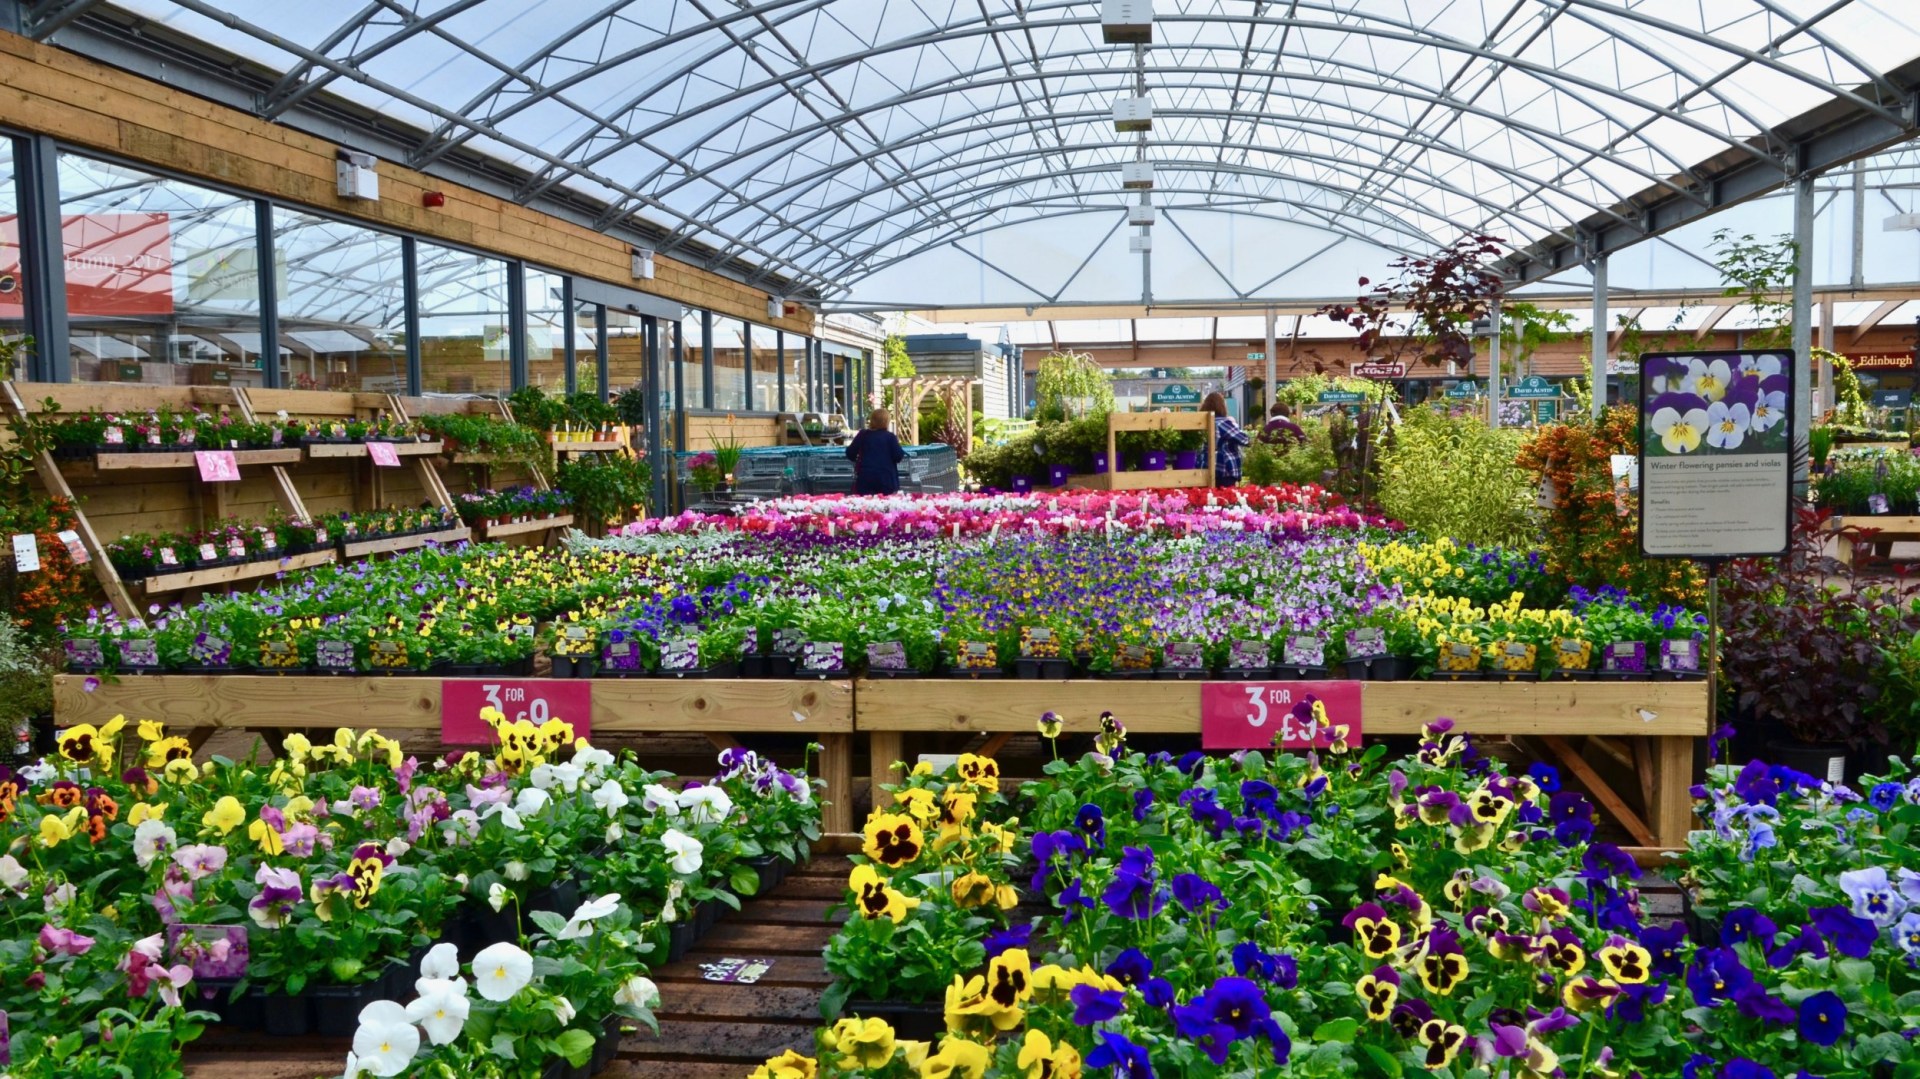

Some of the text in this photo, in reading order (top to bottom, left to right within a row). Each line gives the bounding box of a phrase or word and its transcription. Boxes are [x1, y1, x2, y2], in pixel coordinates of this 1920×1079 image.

[1860, 355, 1913, 368] Edinburgh
[1650, 459, 1781, 471] Winter flowering pansies and violas
[505, 688, 525, 702] FOR
[1245, 686, 1291, 727] 3 FOR
